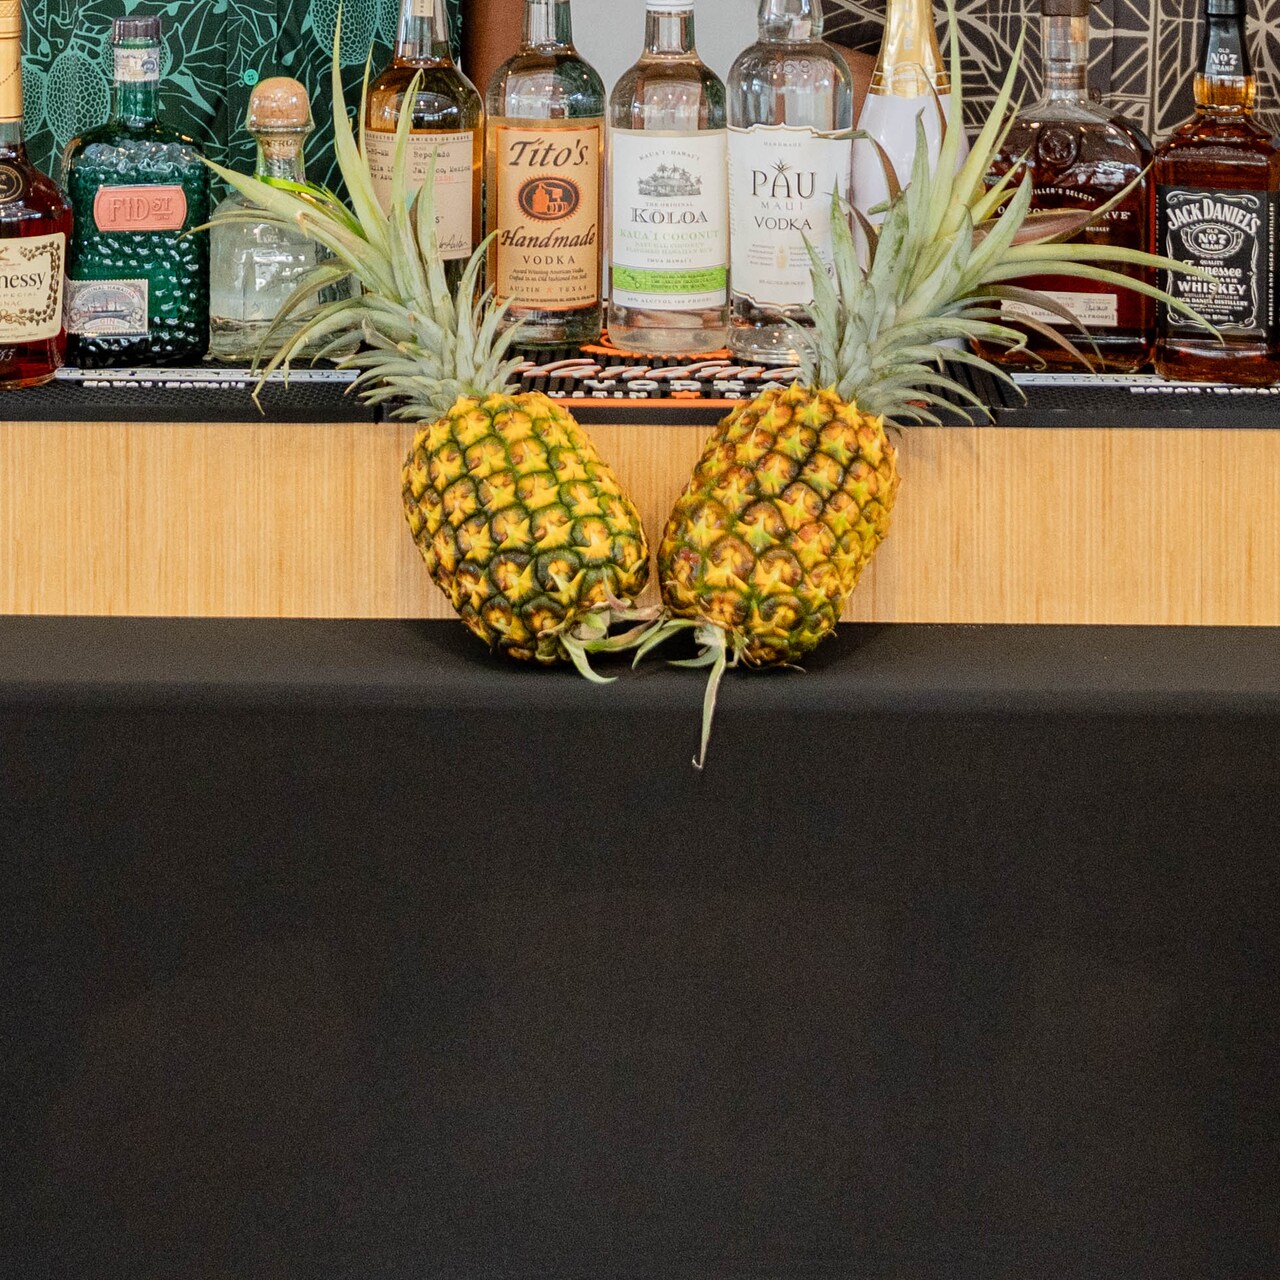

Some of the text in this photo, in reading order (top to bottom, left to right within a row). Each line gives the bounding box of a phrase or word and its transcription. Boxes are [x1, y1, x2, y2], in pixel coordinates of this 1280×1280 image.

[413, 151, 451, 160] Repoado
[508, 138, 589, 167] Tito's
[413, 167, 446, 175] Jalco,
[761, 202, 803, 211] MAUI
[1166, 198, 1261, 236] JACK DANIEL'S
[754, 216, 812, 230] VODKA
[501, 223, 596, 249] Handmade
[662, 230, 720, 241] COCONUT
[523, 255, 575, 265] VODKA
[509, 285, 587, 293] AUSTIN TEXAS
[1177, 281, 1247, 295] WHISKEY
